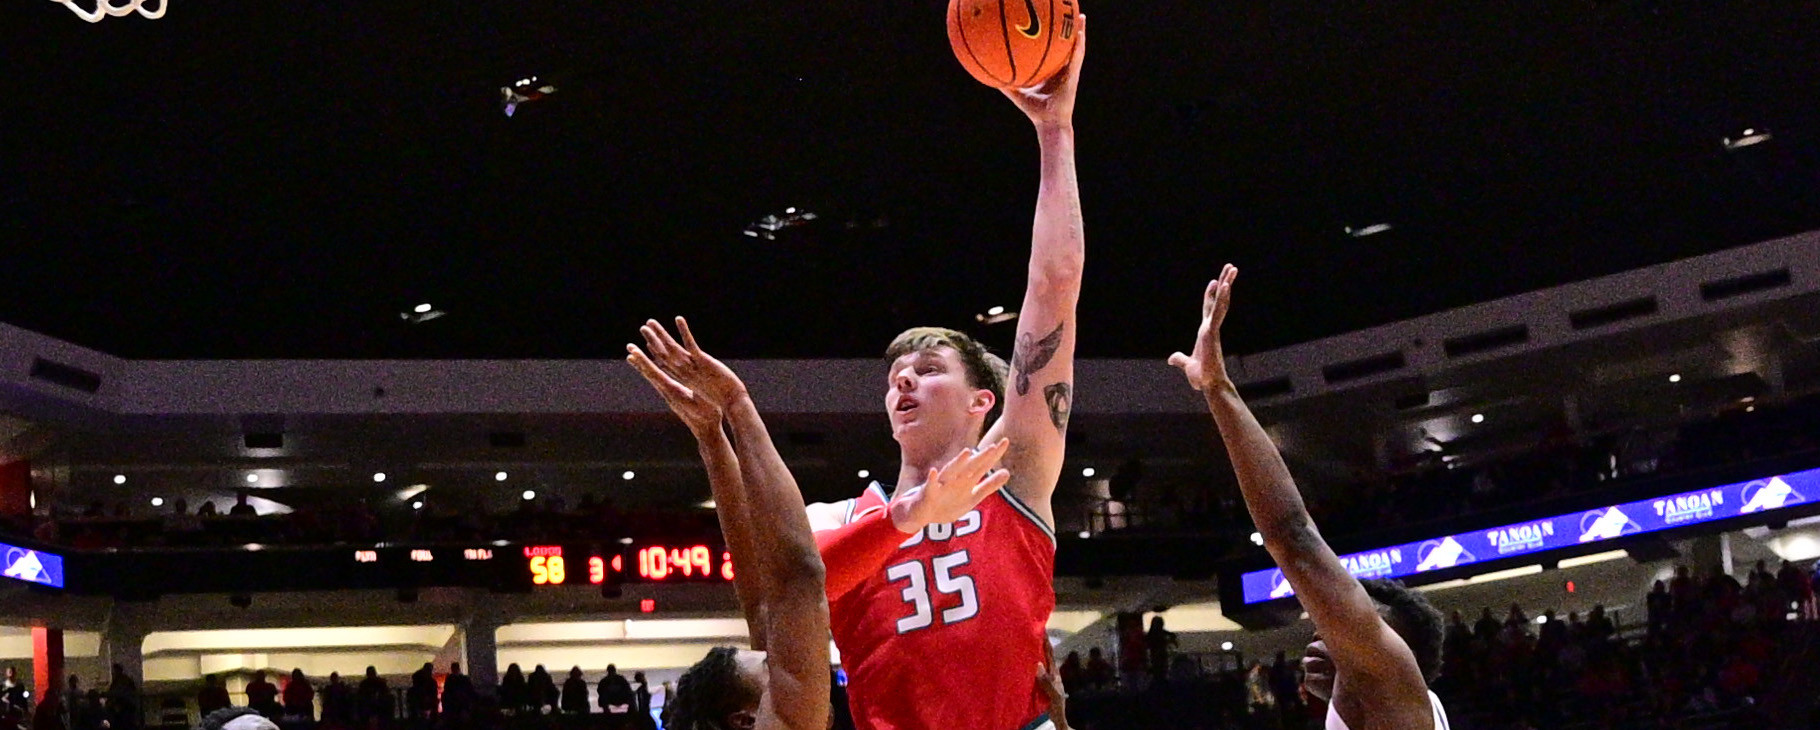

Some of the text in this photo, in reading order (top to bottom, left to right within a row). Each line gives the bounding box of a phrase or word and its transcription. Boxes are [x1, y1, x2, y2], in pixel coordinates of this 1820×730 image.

[1653, 490, 1724, 517] TANOAN
[1487, 521, 1554, 547] TANOAN
[530, 555, 565, 585] 58
[589, 556, 604, 584] 3
[639, 545, 711, 580] 10:49
[887, 550, 980, 634] 35
